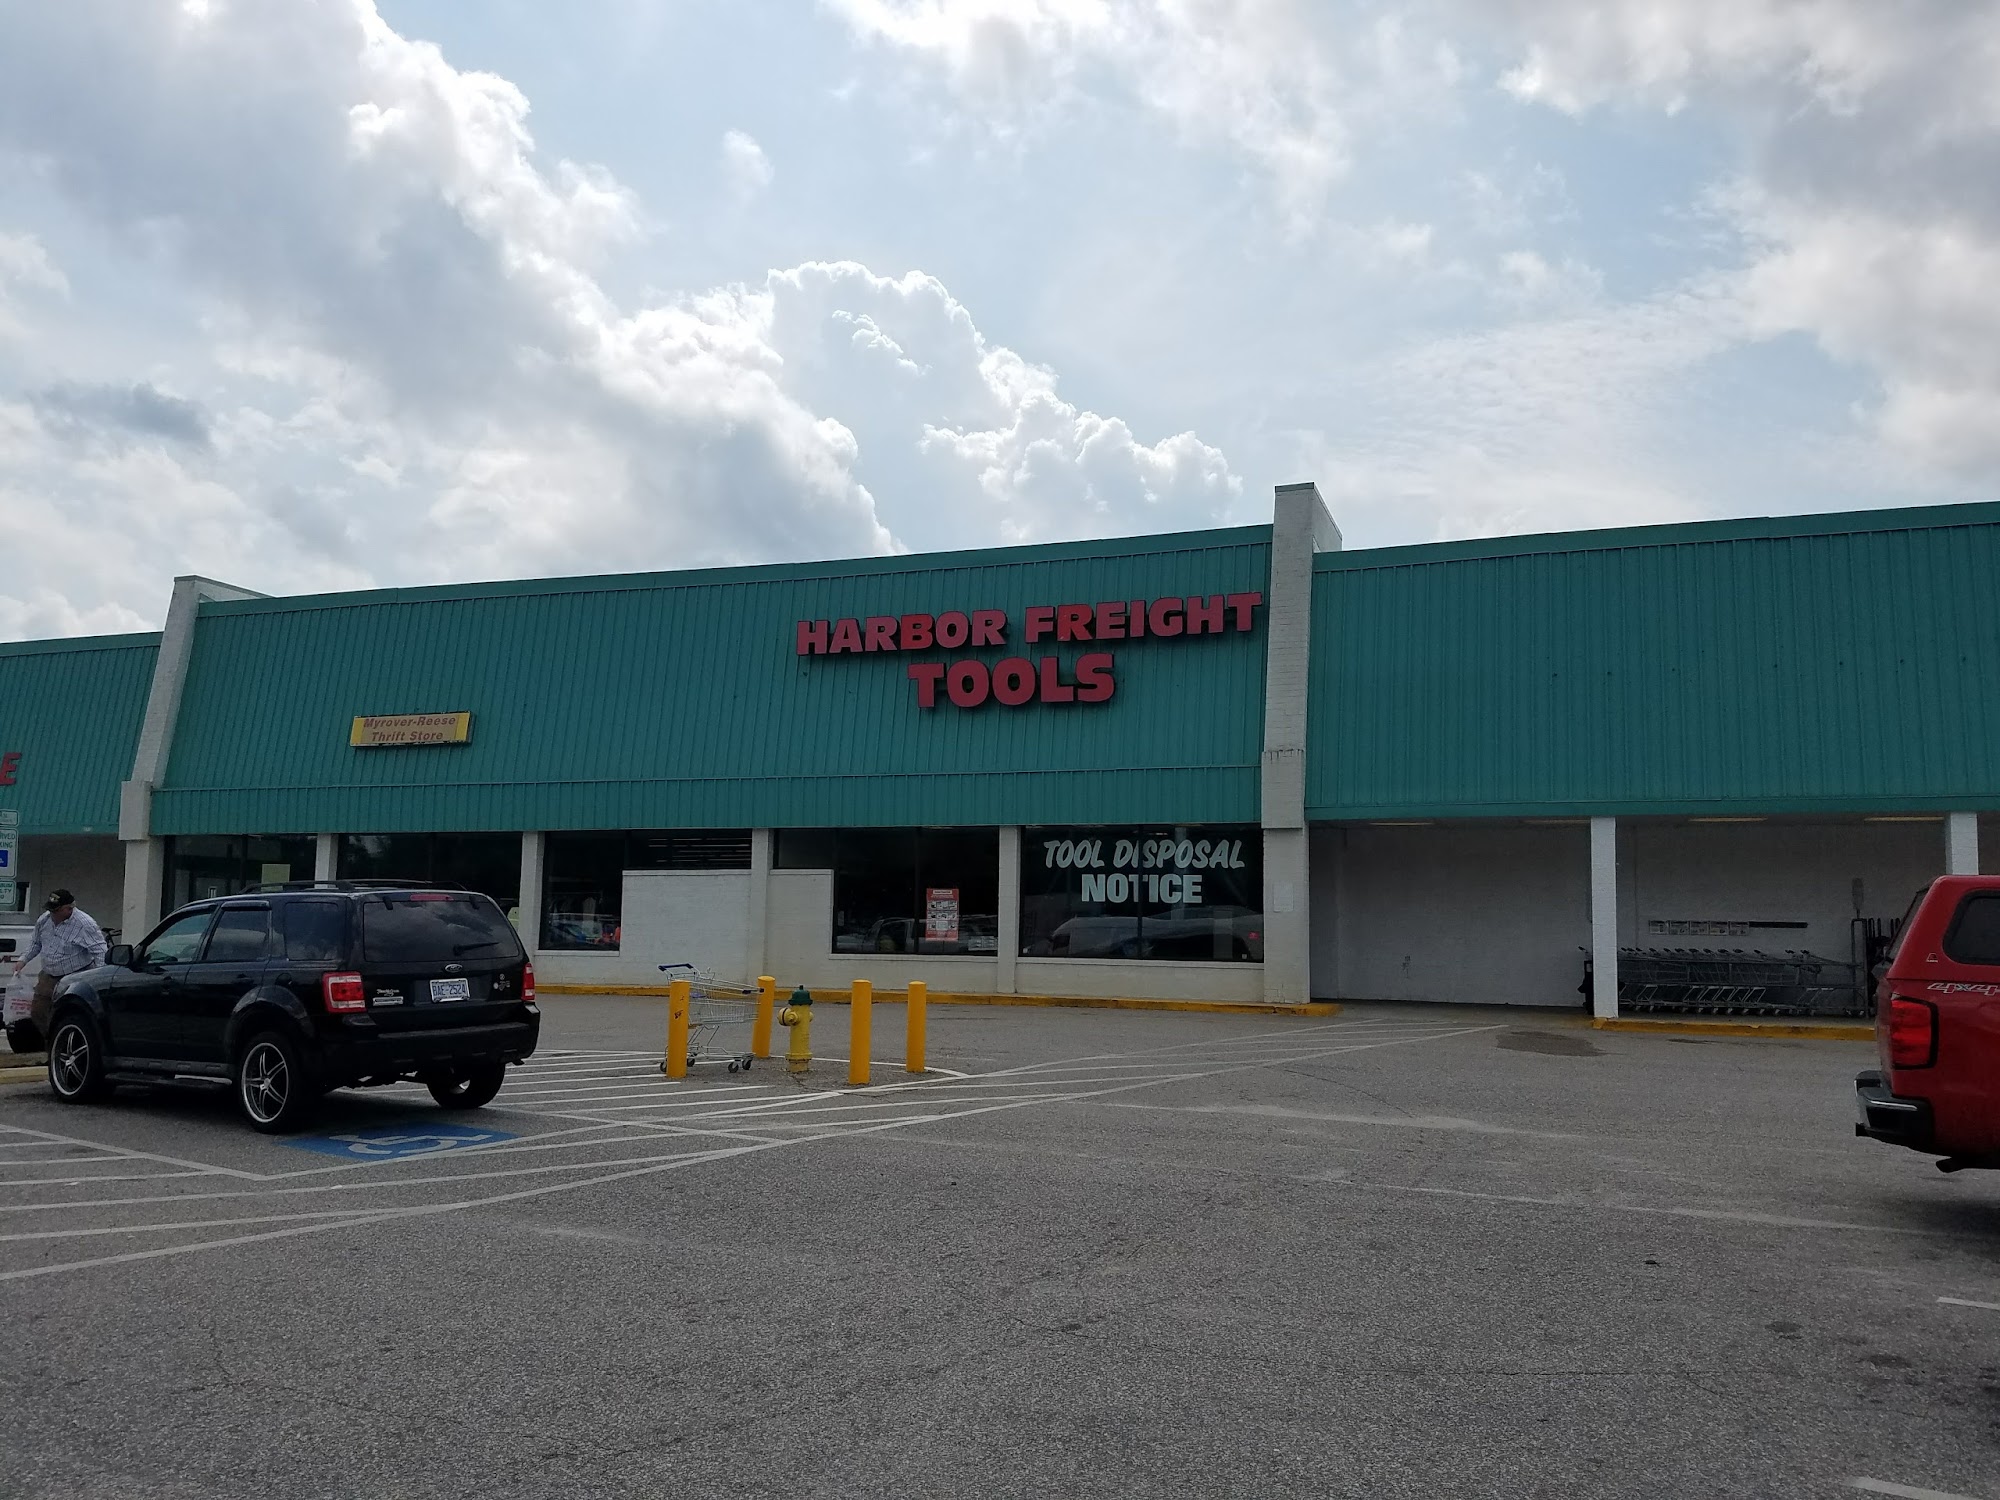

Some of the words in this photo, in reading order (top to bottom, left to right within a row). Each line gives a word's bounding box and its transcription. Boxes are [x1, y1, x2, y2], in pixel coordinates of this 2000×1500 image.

[797, 609, 1007, 656] HARBOR
[1025, 592, 1262, 644] FREIGHT
[907, 653, 1115, 708] TOOLS
[363, 716, 456, 728] Myrover-Reese
[372, 731, 405, 742] Thrift
[409, 730, 444, 741] Store
[1044, 840, 1105, 869] TOOL
[1113, 839, 1246, 869] DISPOSAL
[1081, 873, 1203, 904] NOTICE
